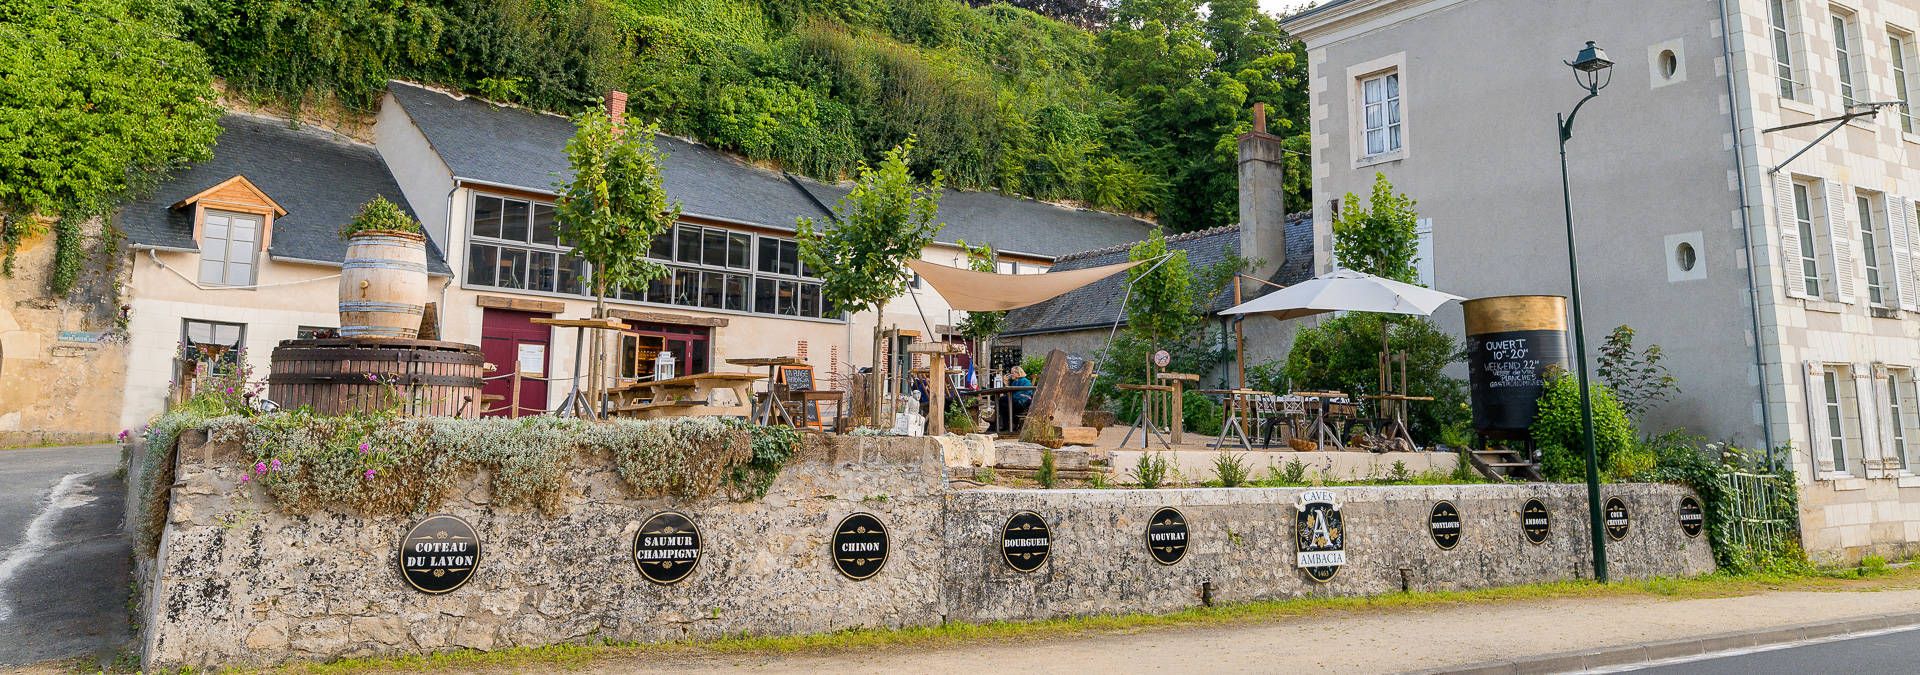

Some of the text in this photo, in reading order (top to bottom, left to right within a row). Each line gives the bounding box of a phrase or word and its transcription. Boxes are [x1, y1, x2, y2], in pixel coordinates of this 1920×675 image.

[1485, 339, 1526, 351] OUVERT
[1303, 491, 1334, 502] CAVES
[1310, 509, 1334, 547] A
[1431, 521, 1460, 529] MONTLOUIS
[644, 536, 693, 547] SAUMUR
[1150, 532, 1186, 541] VOUVRAY
[415, 542, 468, 553] COTEAU
[842, 542, 880, 552] CHINON
[1004, 537, 1049, 548] BOURGUEIL
[637, 549, 699, 560] CHAMPIGNY
[1300, 553, 1343, 565] AMBACIA
[407, 555, 473, 567] DU LAYON
